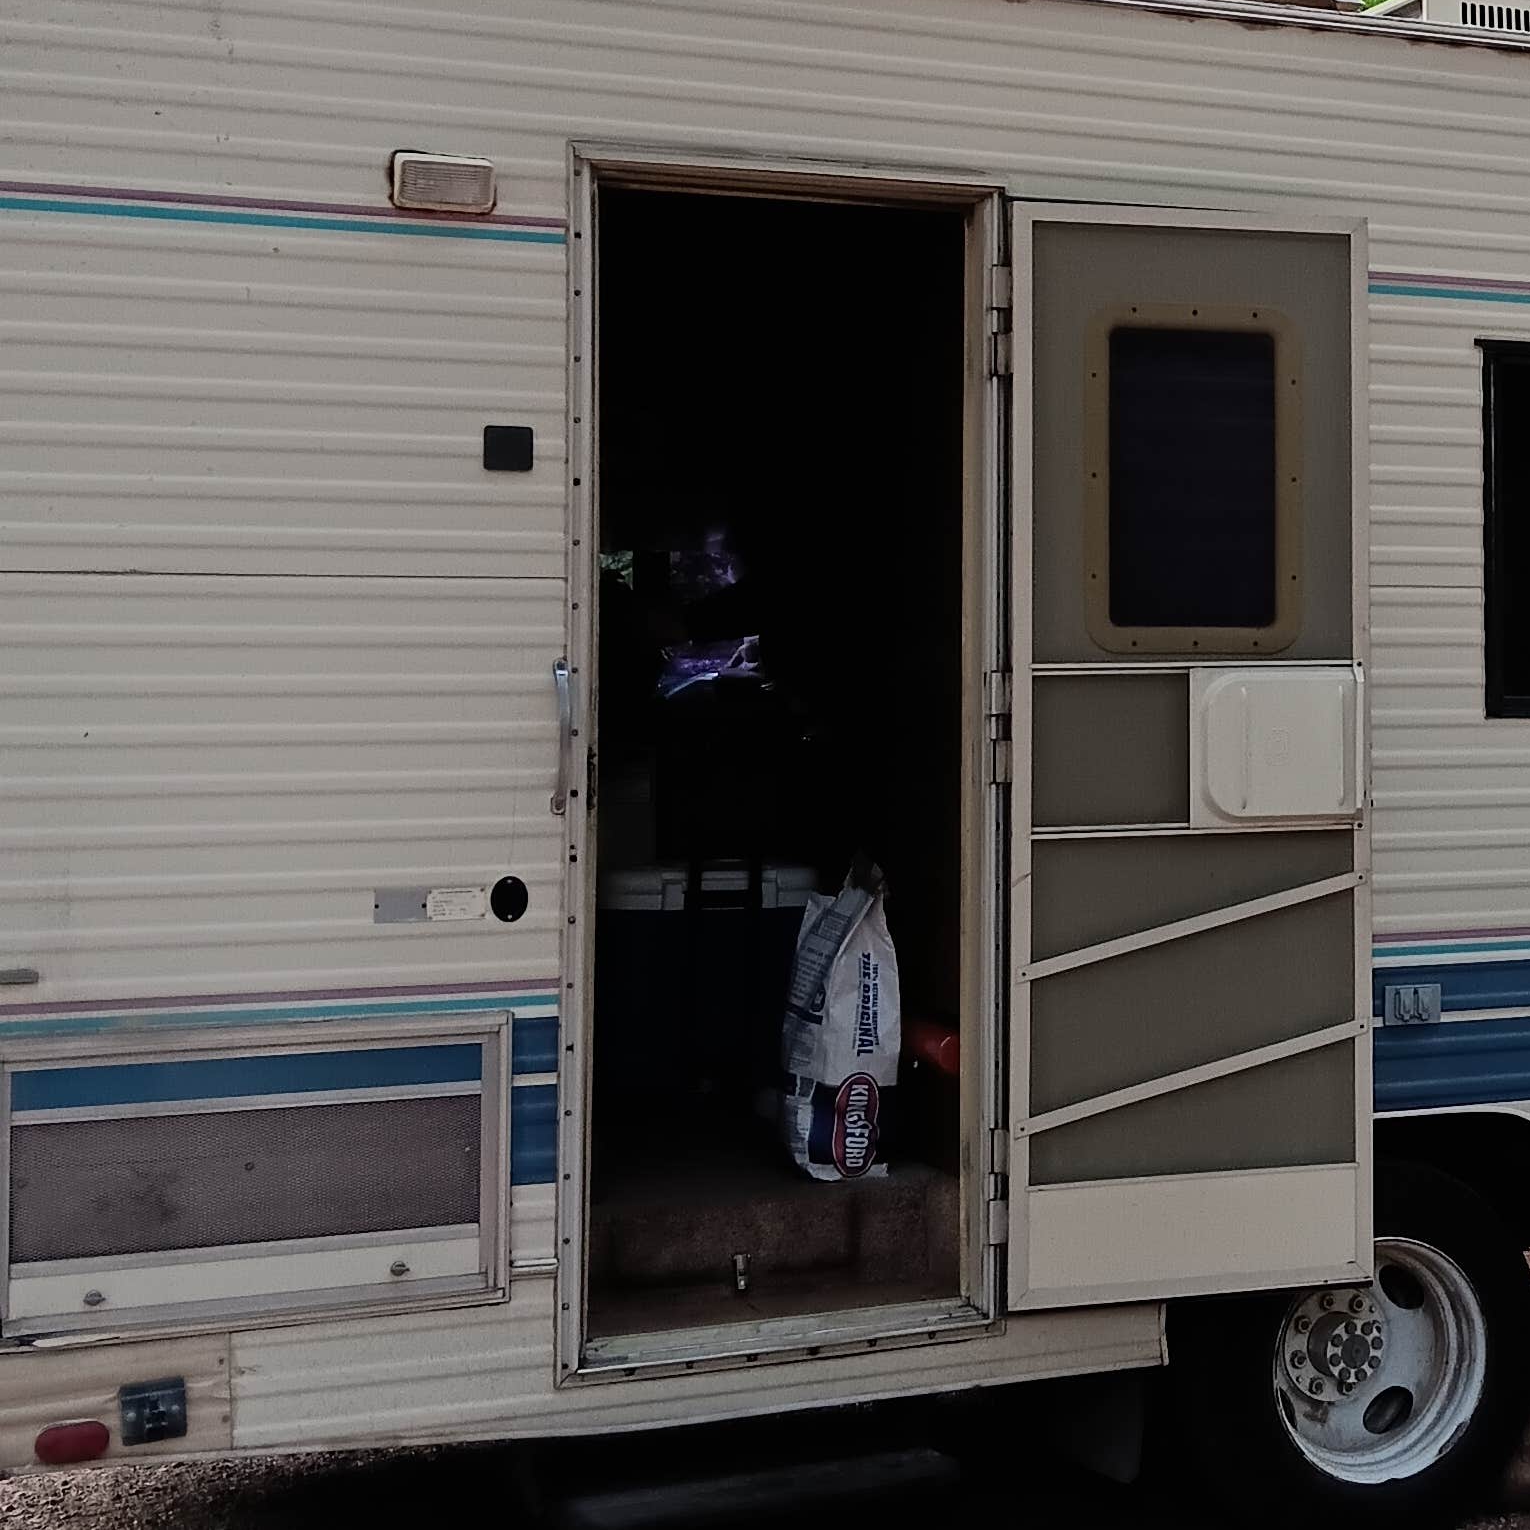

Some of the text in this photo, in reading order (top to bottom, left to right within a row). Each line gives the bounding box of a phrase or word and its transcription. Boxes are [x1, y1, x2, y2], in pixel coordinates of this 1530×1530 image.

[857, 953, 874, 1057] THE ORIGINAL
[844, 1084, 873, 1167] KINGSFORD
